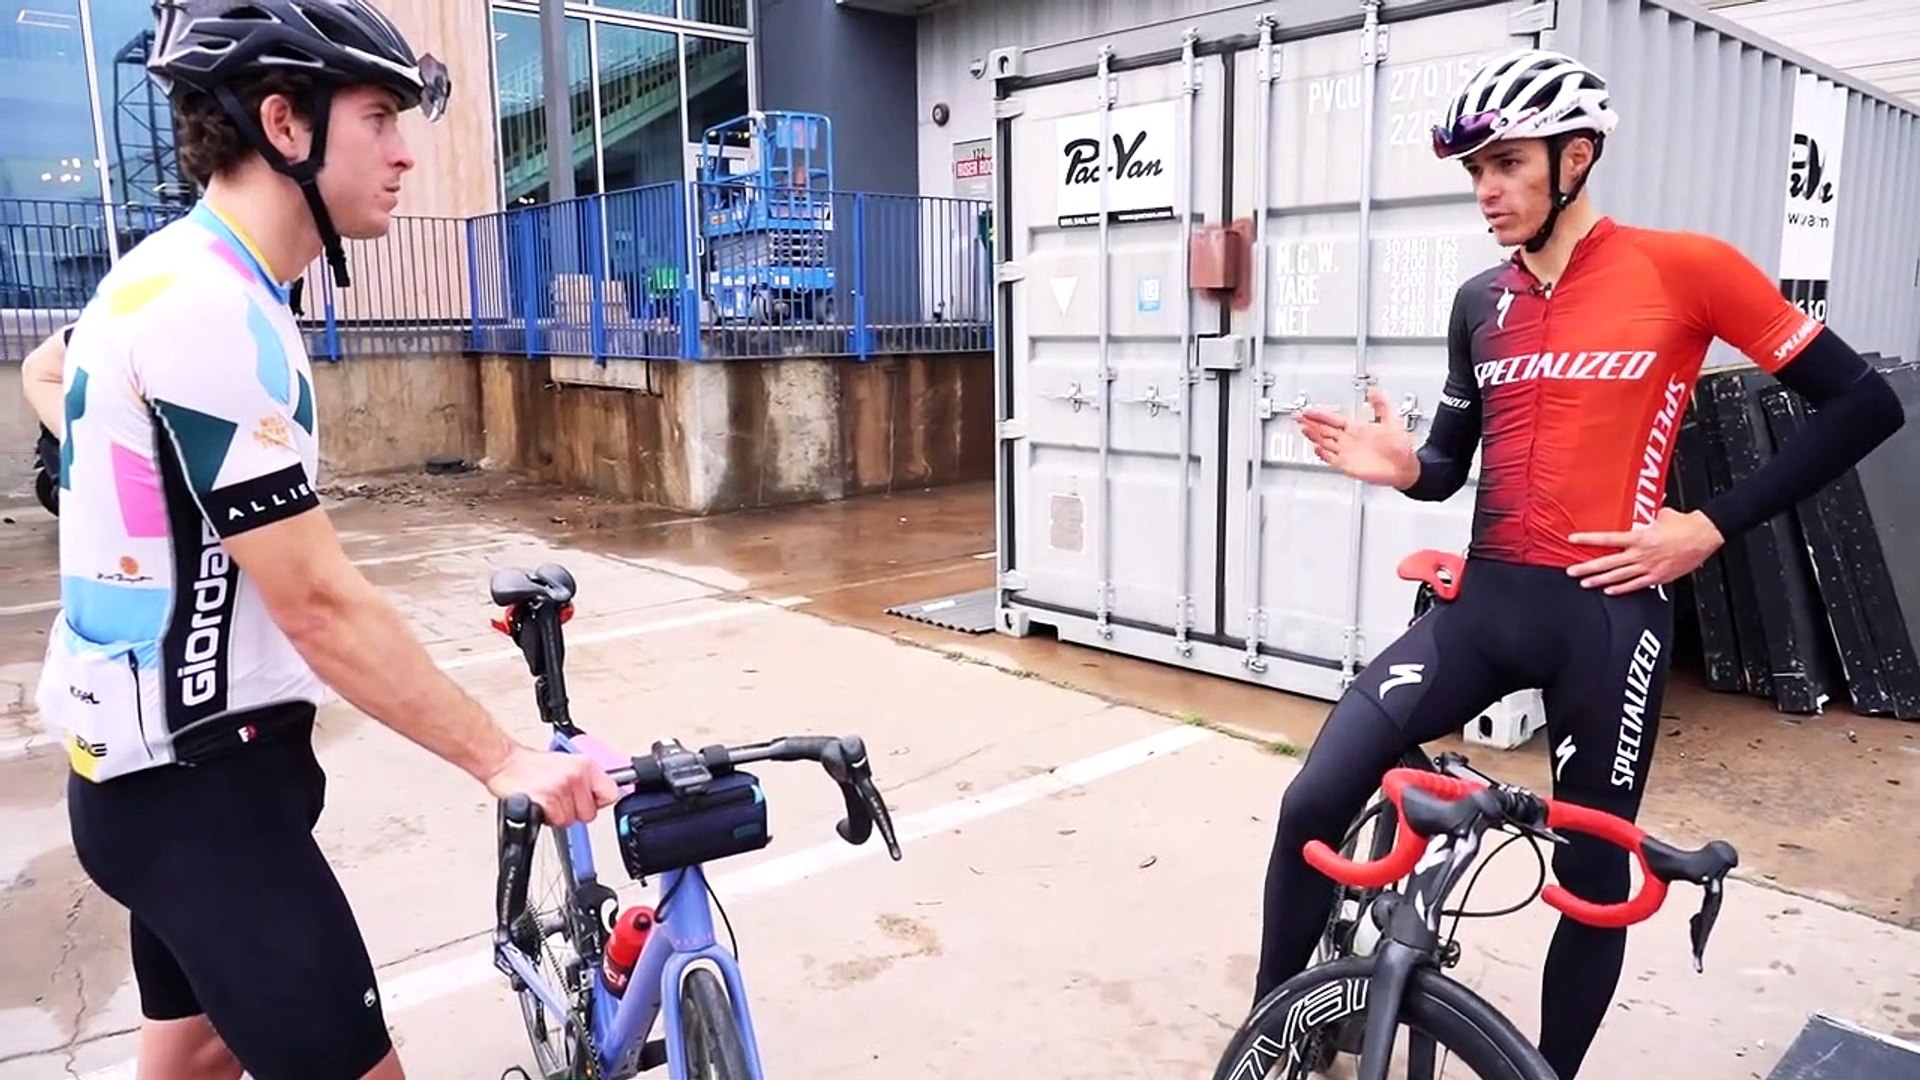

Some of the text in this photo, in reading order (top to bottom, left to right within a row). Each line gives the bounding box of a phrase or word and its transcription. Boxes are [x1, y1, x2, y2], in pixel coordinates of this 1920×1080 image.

[1277, 274, 1320, 305] TARE
[1275, 305, 1312, 336] NET
[1474, 350, 1658, 389] SPECIALIZED
[1611, 628, 1662, 791] SPECIALIZED
